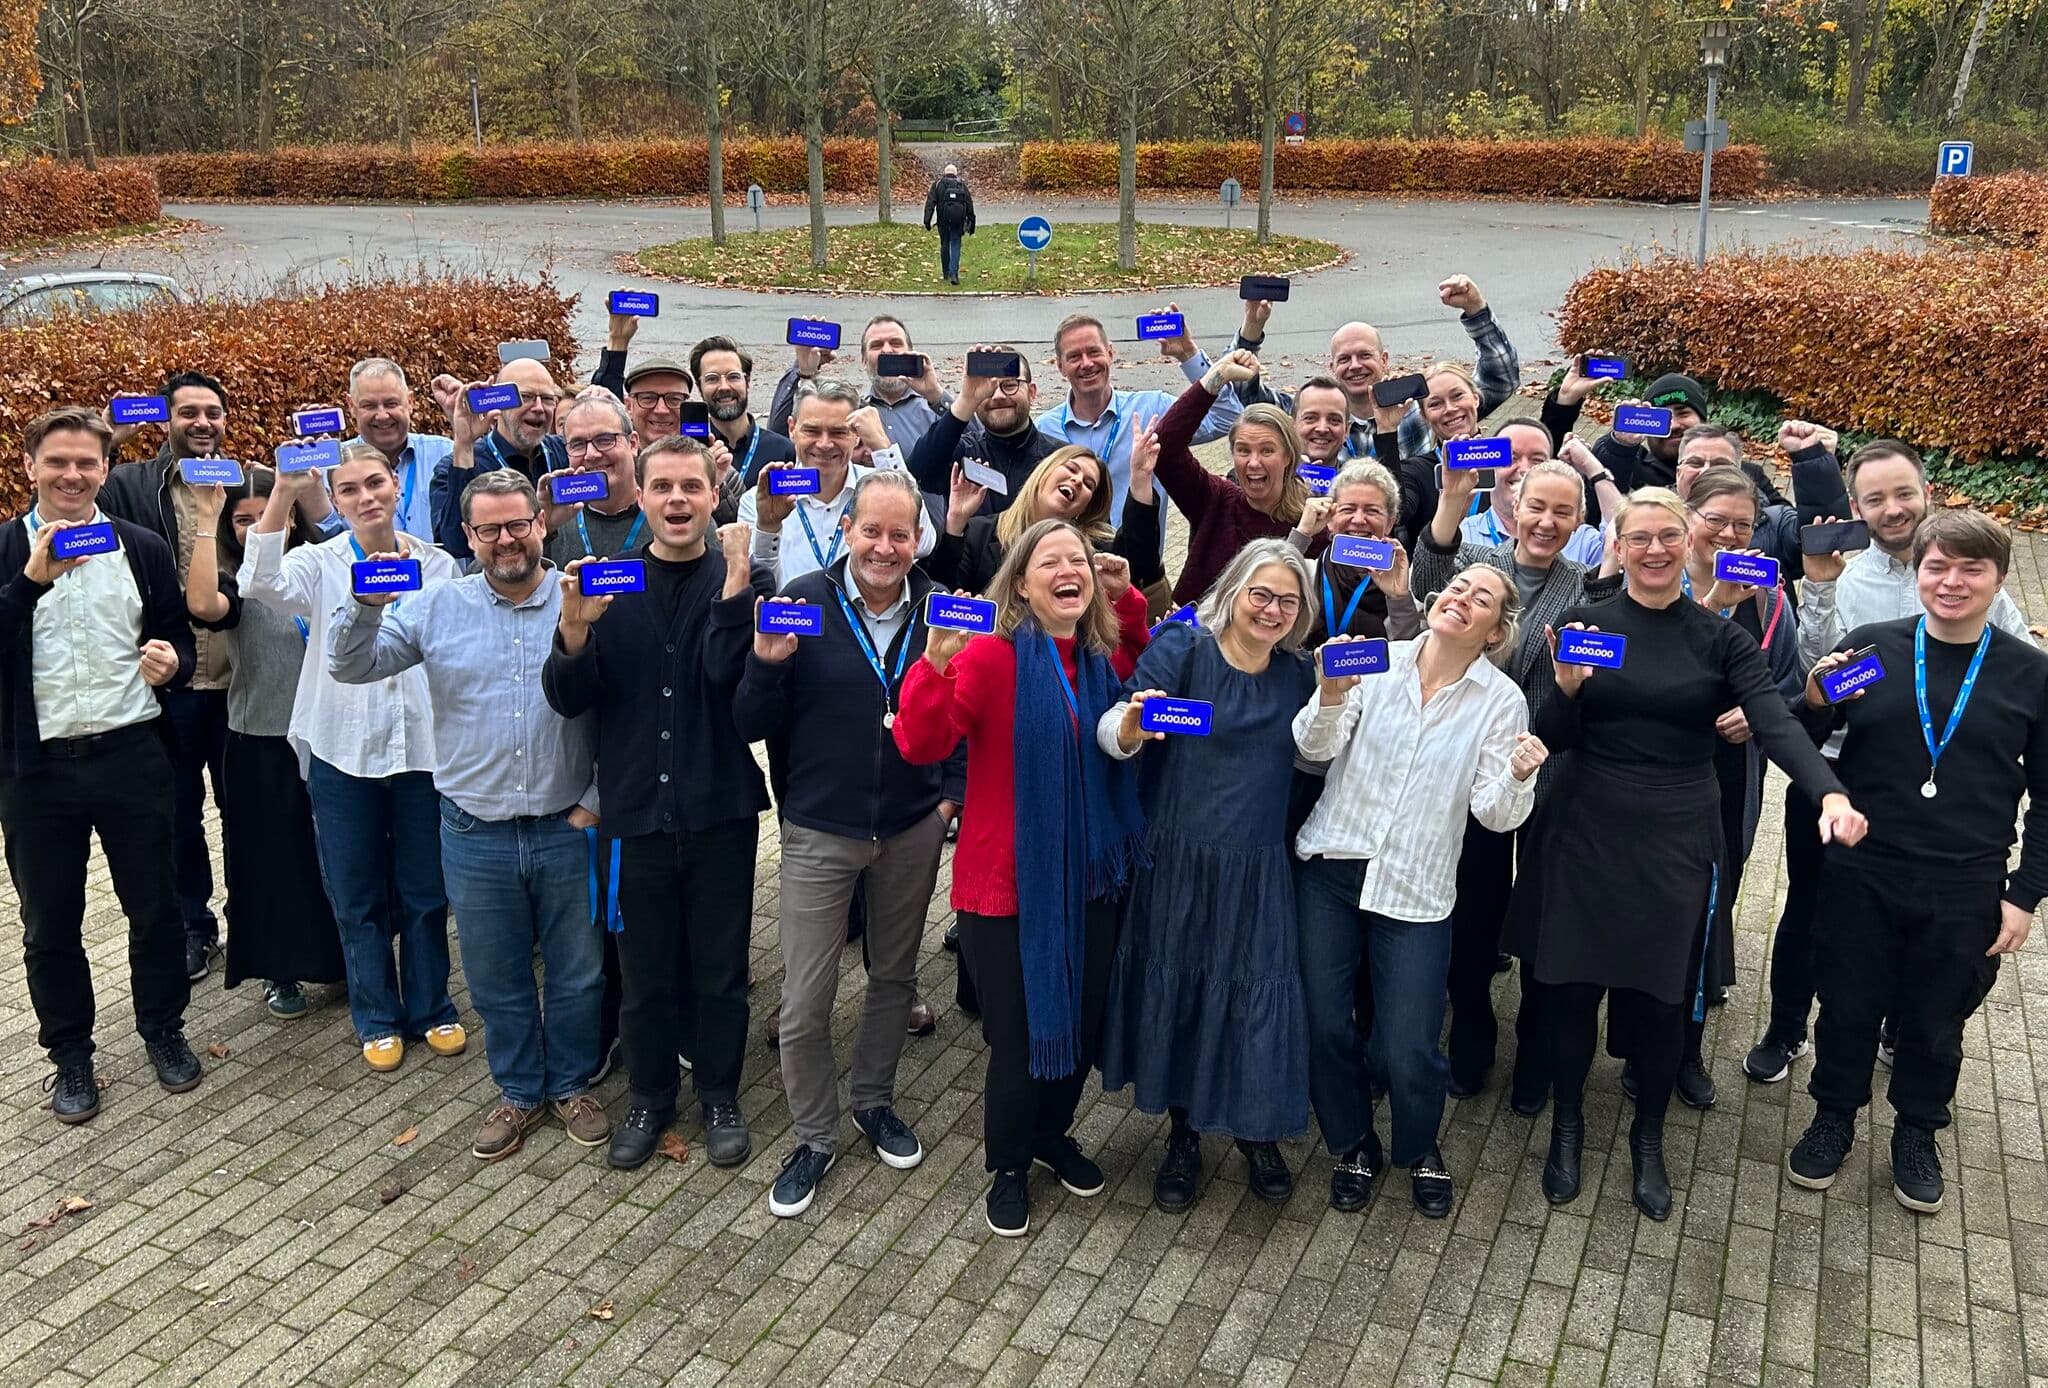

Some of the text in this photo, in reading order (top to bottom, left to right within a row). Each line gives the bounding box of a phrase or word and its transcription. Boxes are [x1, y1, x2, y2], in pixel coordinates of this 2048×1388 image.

[1947, 149, 1964, 172] P
[797, 331, 831, 341] 2.000.000
[122, 408, 159, 416] 2.000.000
[1624, 418, 1661, 428] 2.000.000
[289, 453, 330, 464] 2.000.000
[1456, 451, 1501, 461] 2.000.000
[193, 469, 231, 477] 2.000.000
[777, 479, 811, 488] 2.000.000
[560, 485, 598, 496] 2.000.000
[64, 537, 106, 550] 2.000.000
[1342, 549, 1383, 561] 2.000.000
[1726, 565, 1767, 577] 2.000.000
[364, 574, 410, 584] 2.000.000
[591, 576, 635, 586] 2.000.000
[940, 609, 983, 622] 2.000.000
[769, 616, 813, 627] 2.000.000
[1569, 645, 1614, 658] 2.000.000
[1334, 656, 1378, 668] 2.000.000
[1834, 668, 1877, 694] 2.000.000
[1152, 713, 1201, 726] 2.000.000
